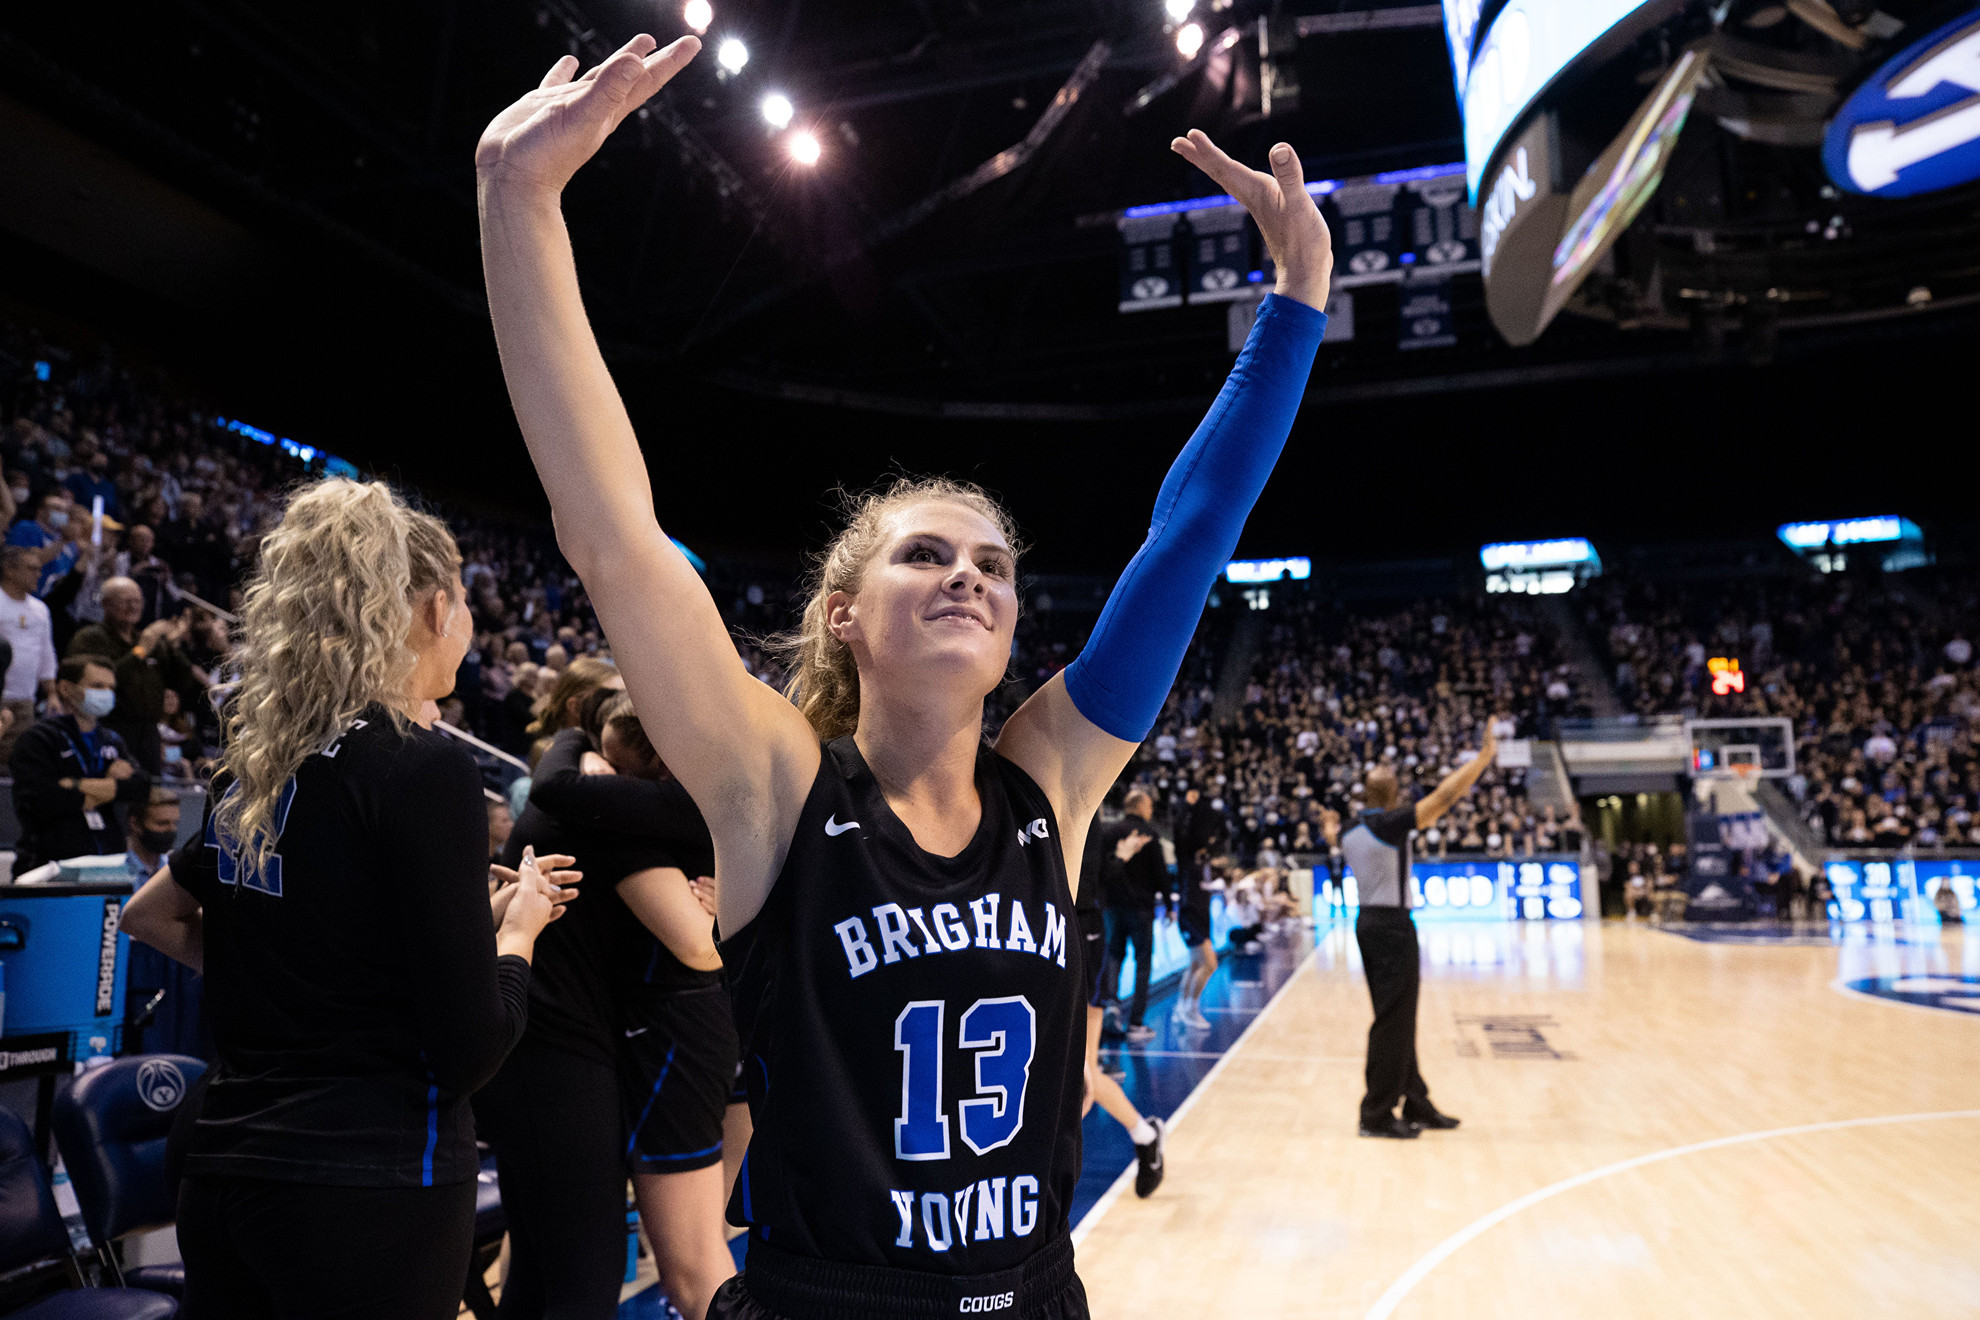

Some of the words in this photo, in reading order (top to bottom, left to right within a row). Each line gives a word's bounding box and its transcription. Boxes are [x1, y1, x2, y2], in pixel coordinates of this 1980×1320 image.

[97, 903, 120, 1012] POWERADE
[833, 892, 1067, 980] BRIGHAM
[894, 994, 1037, 1161] 13
[890, 1174, 1040, 1252] YOUNG
[959, 1291, 1015, 1313] COUGS
